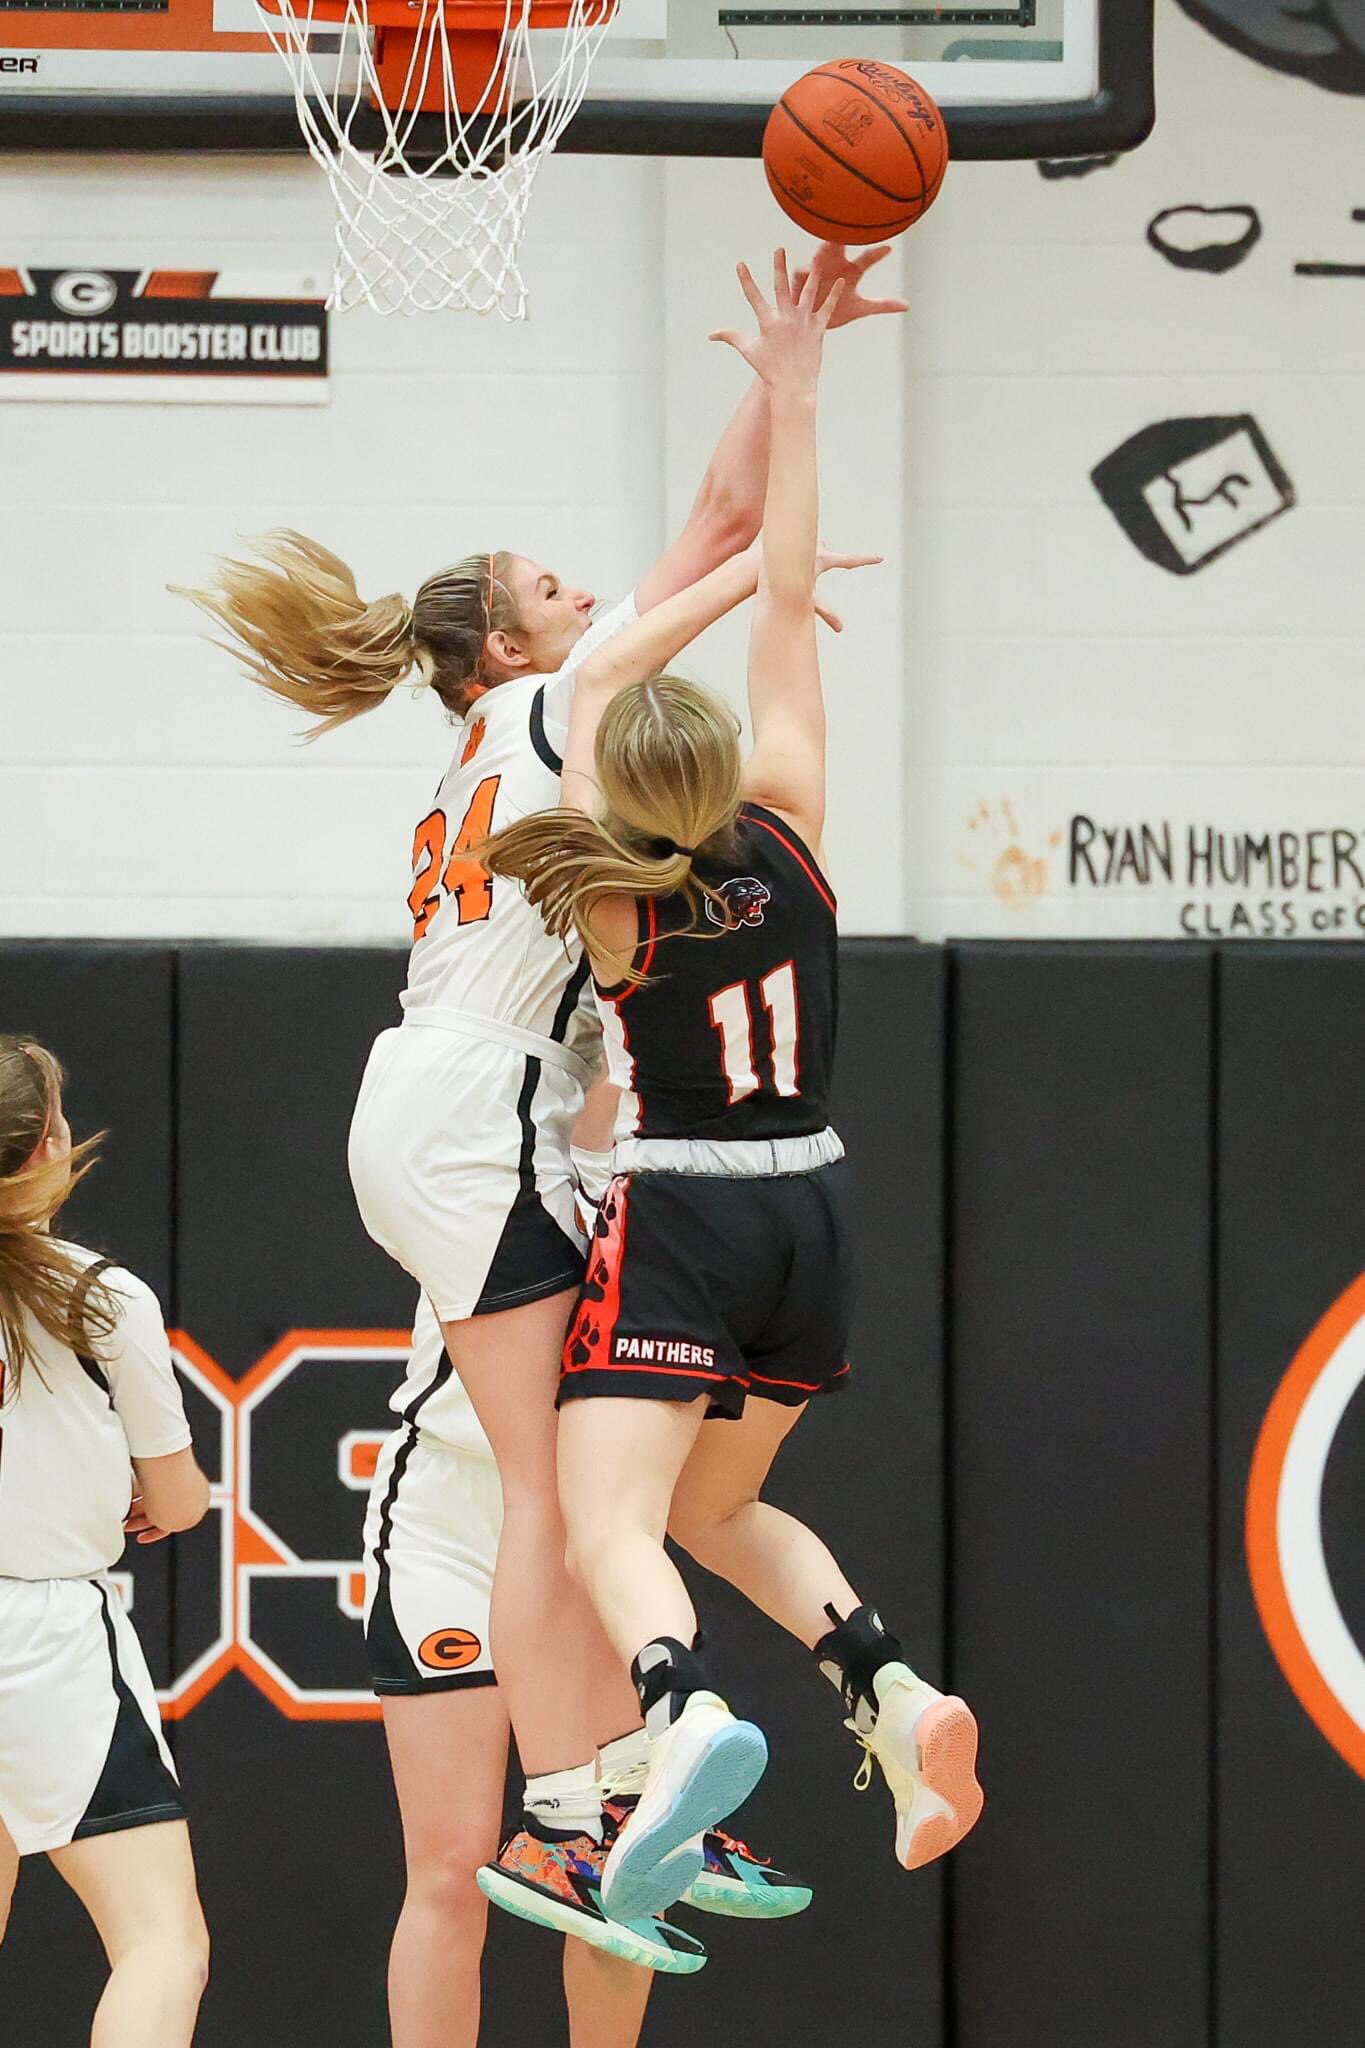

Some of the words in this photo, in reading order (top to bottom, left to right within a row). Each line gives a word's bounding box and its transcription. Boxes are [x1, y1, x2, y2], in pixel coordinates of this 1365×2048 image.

[839, 60, 935, 132] Rawlings
[11, 321, 118, 358] SPORTS
[123, 322, 247, 360] BOOSTER
[251, 324, 321, 362] CLUB
[407, 774, 502, 944] 24
[1069, 814, 1175, 888] RYAN
[1187, 826, 1365, 891] HUMBER
[1180, 901, 1298, 938] CLASS
[708, 960, 802, 1106] 11
[615, 1337, 716, 1368] PANTHERS
[417, 1627, 482, 1670] G
